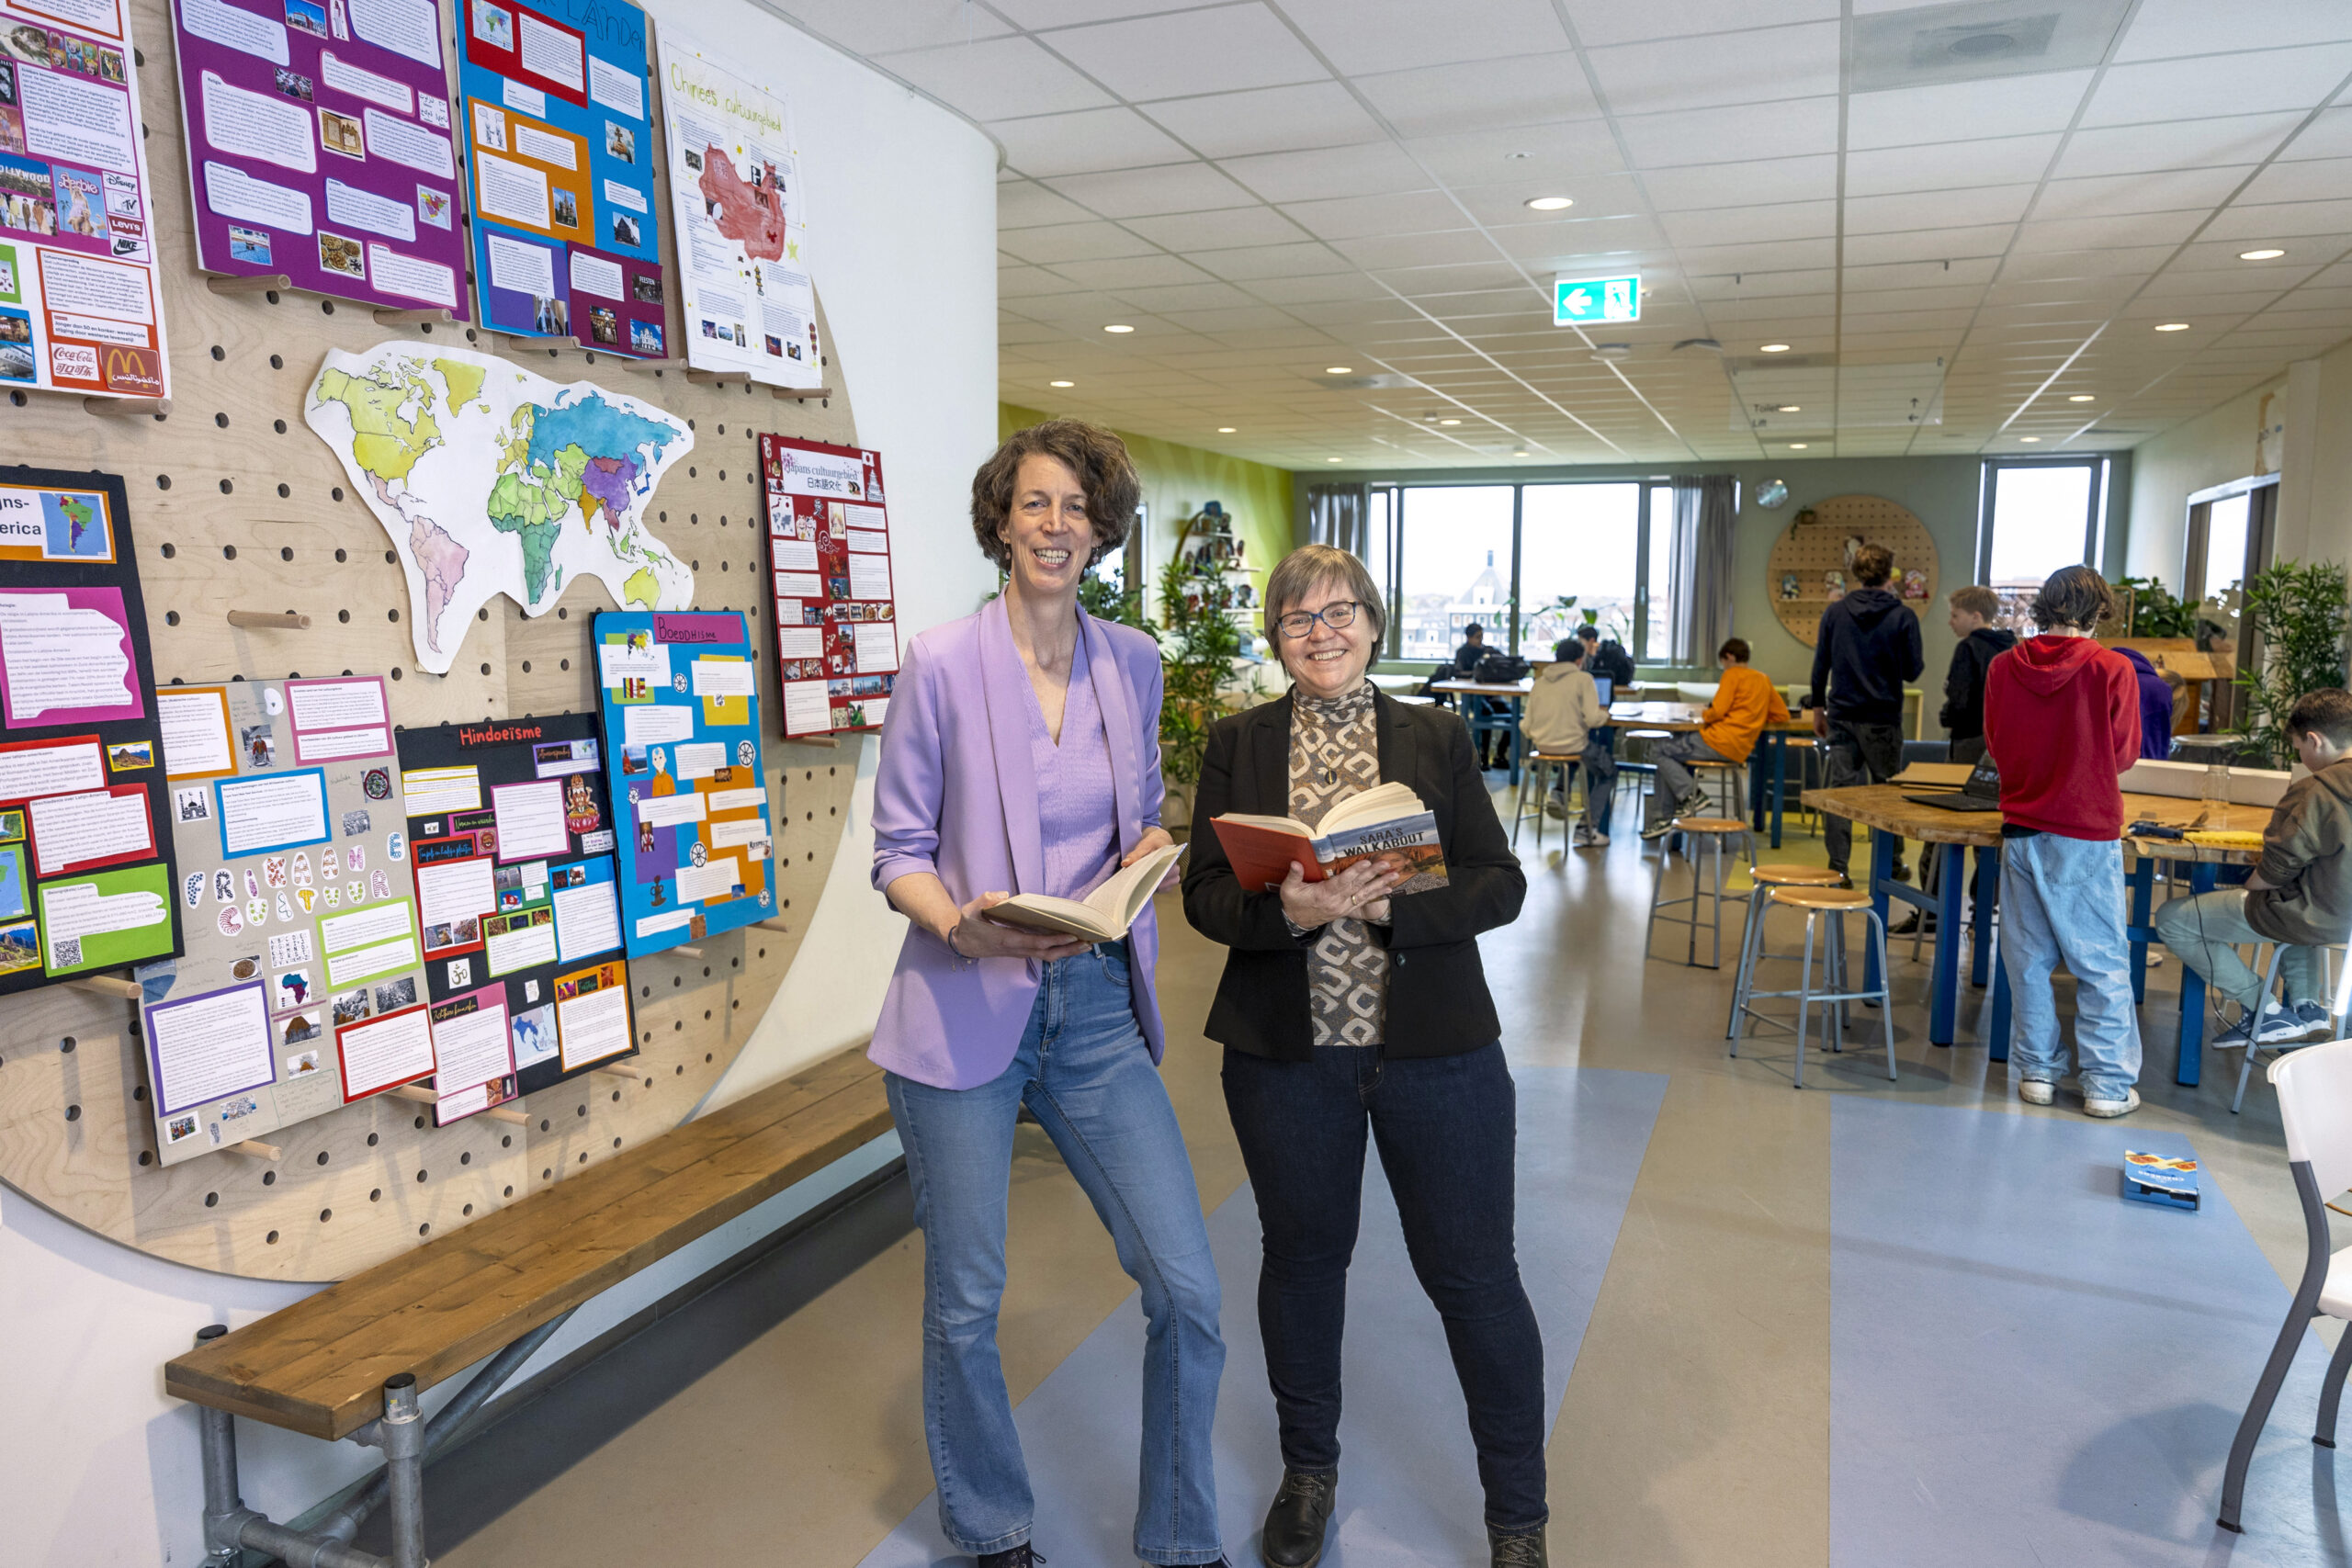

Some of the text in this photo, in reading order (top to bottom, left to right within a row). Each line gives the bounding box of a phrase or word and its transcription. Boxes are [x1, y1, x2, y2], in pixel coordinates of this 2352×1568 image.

[671, 62, 718, 107] Chinees
[725, 89, 782, 136] cultuurgebied
[117, 239, 138, 252] NIKE
[459, 725, 542, 746] Hindoeïsme
[1343, 831, 1424, 857] WALKABOUT
[1360, 828, 1404, 845] SARA'S
